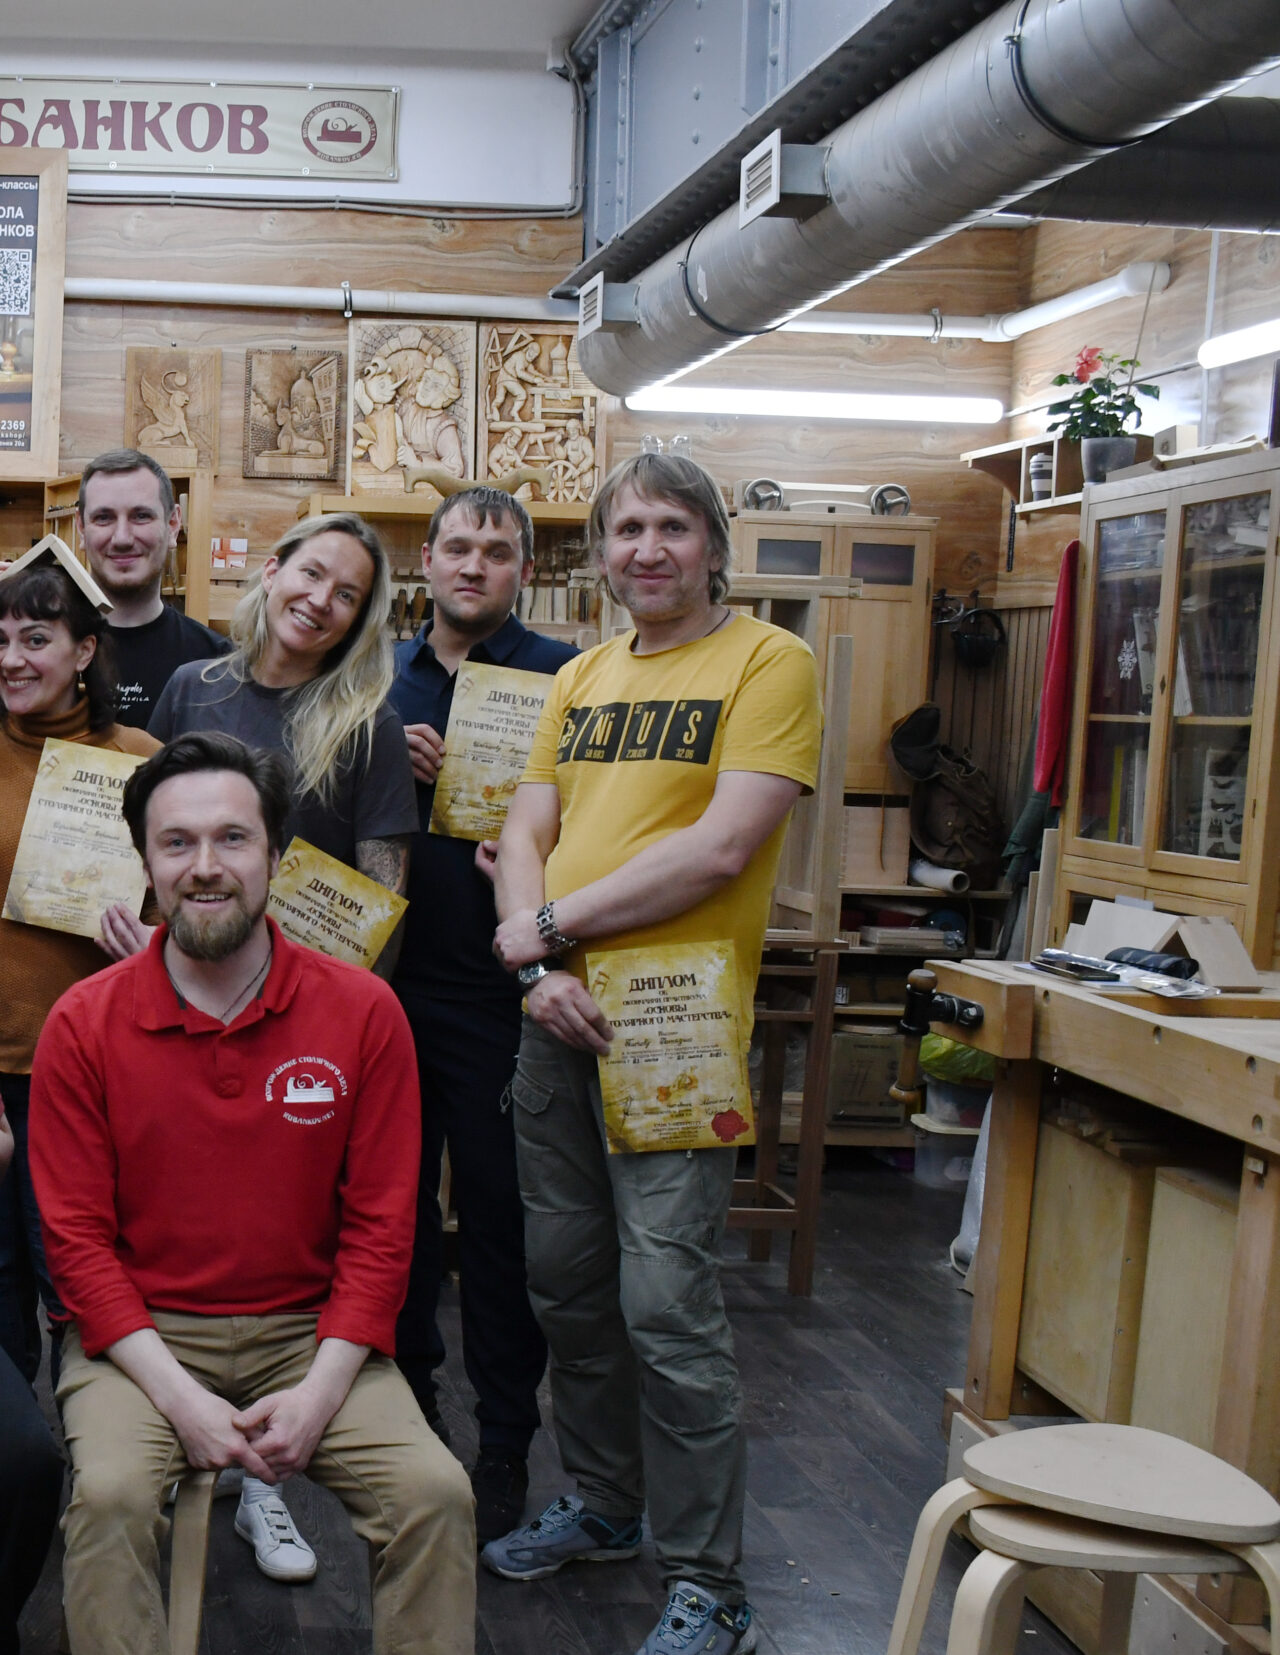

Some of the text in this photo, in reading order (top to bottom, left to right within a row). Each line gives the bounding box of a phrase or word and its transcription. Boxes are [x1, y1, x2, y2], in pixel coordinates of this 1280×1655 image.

[486, 690, 545, 709] ДИПЛОМ
[588, 712, 616, 746] Ni
[636, 710, 656, 745] U
[682, 710, 702, 745] S
[306, 878, 364, 917] ДИПЛОМ
[628, 973, 697, 993] ДИПЛОМ
[608, 1016, 664, 1027] ТОЛЯРНОГО
[298, 1056, 341, 1076] СТОЛЯРНОГО
